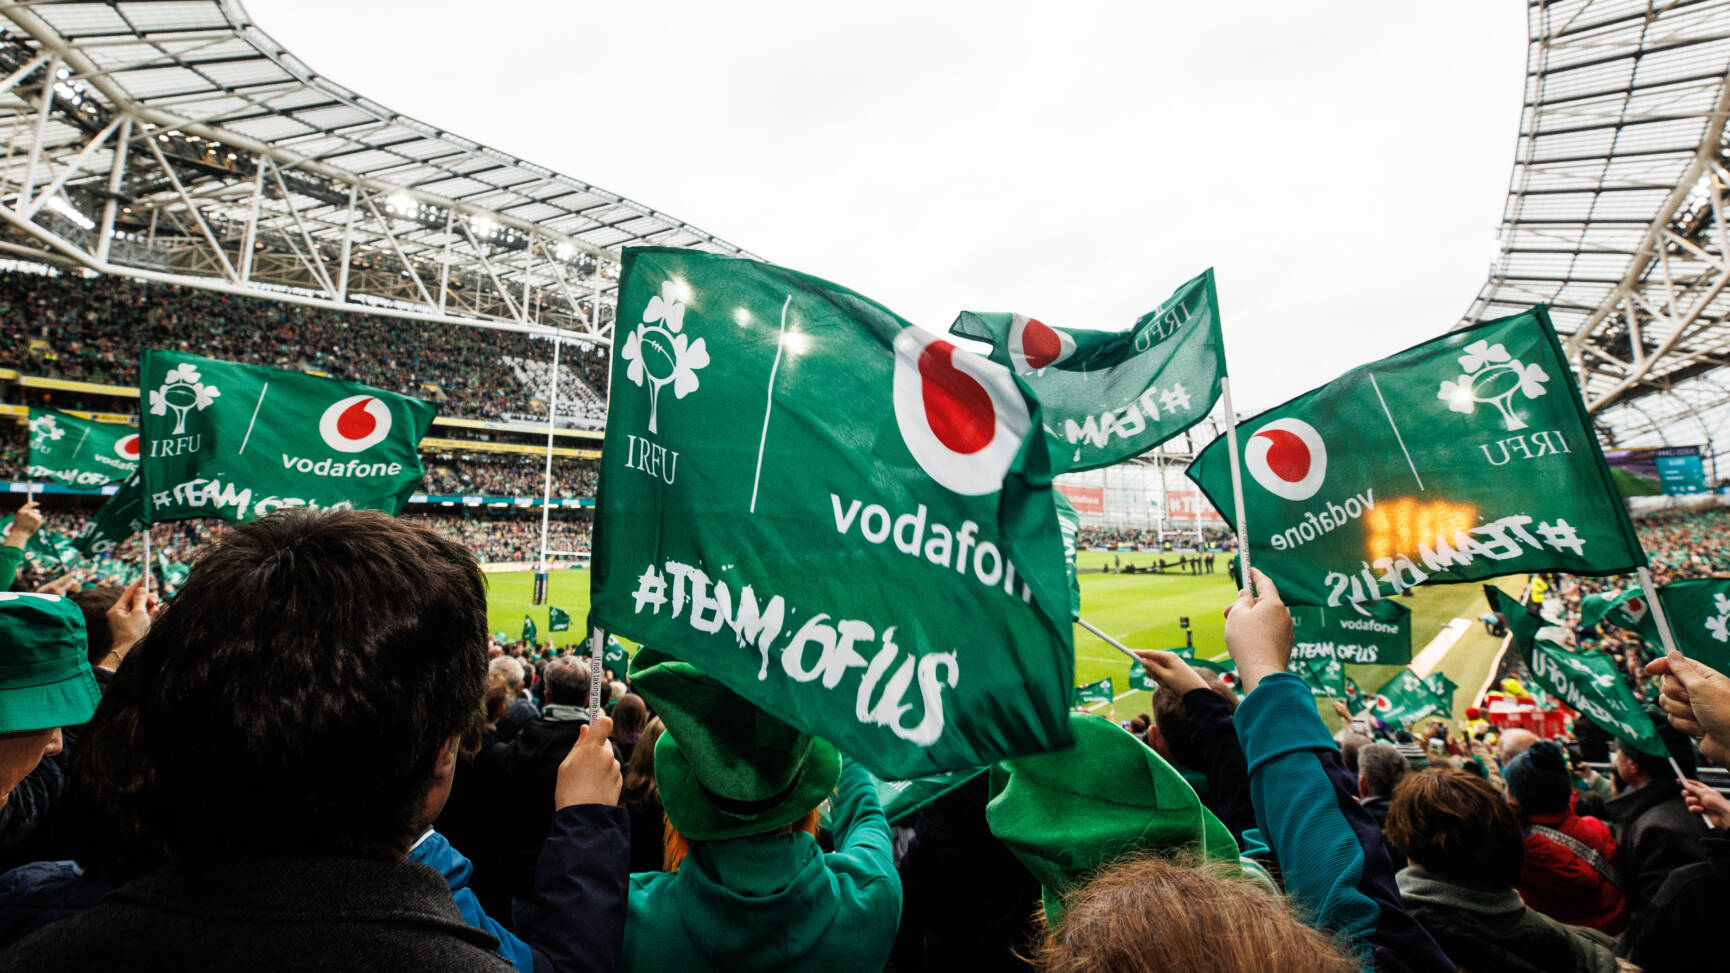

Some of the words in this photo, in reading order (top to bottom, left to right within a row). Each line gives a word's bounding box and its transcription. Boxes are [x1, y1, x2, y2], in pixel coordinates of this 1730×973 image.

[150, 433, 201, 458] IRFU
[281, 453, 402, 478] vodafone
[624, 434, 679, 485] IRFU
[1339, 618, 1400, 635] vodafone
[592, 675, 601, 697] taking
